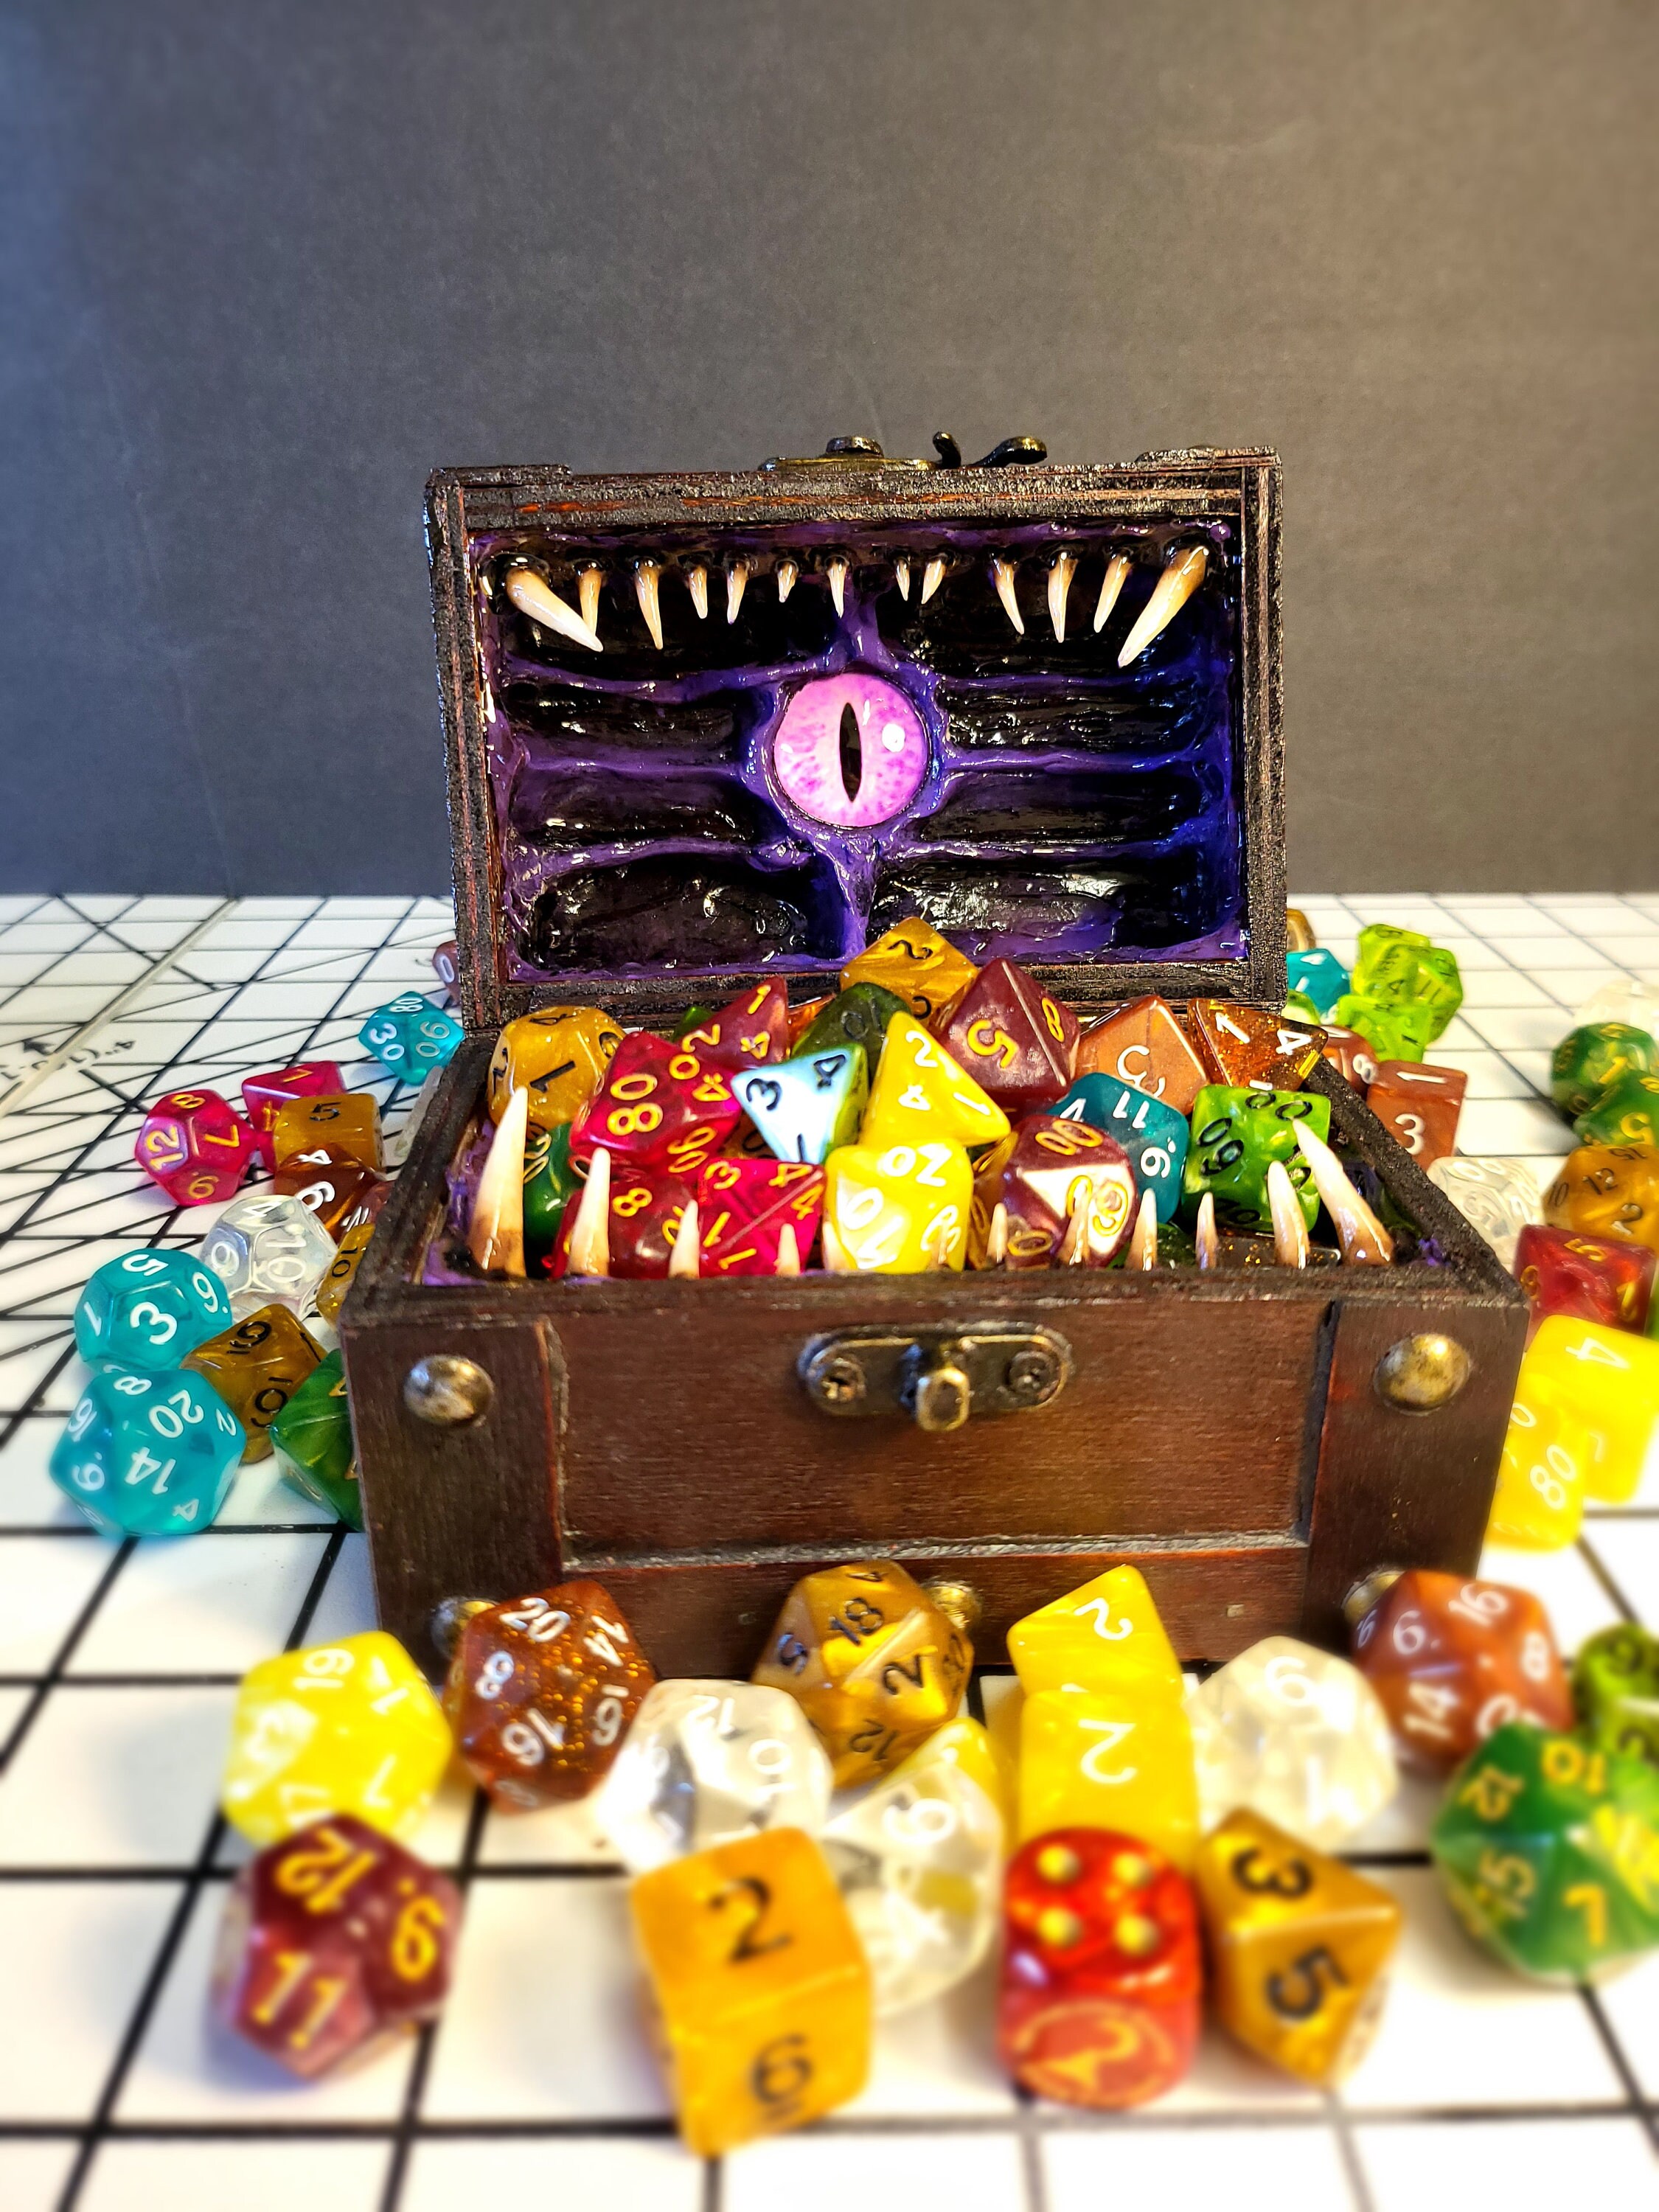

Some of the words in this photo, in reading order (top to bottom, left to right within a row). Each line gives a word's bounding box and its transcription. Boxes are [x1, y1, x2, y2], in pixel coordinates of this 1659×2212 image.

[887, 939, 933, 960] 2
[389, 998, 424, 1013] 80
[748, 984, 771, 1015] 1
[682, 1023, 721, 1053] 2
[1040, 997, 1065, 1043] 8
[1216, 1012, 1251, 1045] 1
[370, 1023, 405, 1061] 30
[740, 1032, 771, 1060] 4
[905, 1031, 939, 1068] 2
[967, 1020, 1016, 1069] 5
[1276, 1029, 1312, 1055] 4
[529, 1060, 577, 1093] 1
[813, 1054, 846, 1091] 4
[1352, 1054, 1378, 1085] 8
[1396, 1071, 1447, 1085] 1
[1598, 1056, 1629, 1085] 1
[171, 1093, 206, 1109] 8
[309, 1102, 342, 1121] 5
[607, 1074, 664, 1135] 80
[746, 1077, 782, 1111] 3
[898, 1085, 932, 1111] 4
[952, 1091, 991, 1117] 1
[1113, 1091, 1150, 1129] 11
[1245, 1092, 1313, 1121] 00
[262, 1101, 281, 1132] 4
[1395, 1113, 1425, 1155] 3
[145, 1125, 184, 1171] 12
[204, 1124, 240, 1148] 7
[1035, 1119, 1104, 1156] 00
[704, 1161, 742, 1190] 3
[768, 1163, 813, 1188] 4
[1581, 1167, 1618, 1196] 12
[243, 1200, 283, 1218] 4
[613, 1187, 653, 1217] 8
[790, 1183, 826, 1220] 4
[1610, 1203, 1644, 1237] 2
[702, 1211, 732, 1248] 1
[122, 1253, 170, 1276] 5
[265, 1234, 307, 1284] 10
[717, 1247, 757, 1270] 1
[1563, 1239, 1609, 1262] 5
[83, 1302, 102, 1337] 1
[130, 1301, 178, 1346] 3
[1565, 1337, 1632, 1370] 4
[113, 1375, 153, 1396] 8
[148, 1389, 205, 1439] 20
[215, 1408, 237, 1436] 2
[124, 1446, 177, 1495] 14
[1529, 1444, 1578, 1510] 80
[172, 1498, 200, 1523] 4
[499, 1597, 571, 1643] 20
[830, 1597, 883, 1646] 18
[1074, 1598, 1133, 1641] 2
[1447, 1582, 1508, 1627] 16
[583, 1615, 630, 1667] 14
[1520, 1631, 1550, 1683] 8
[292, 1647, 355, 1691] 19
[476, 1650, 515, 1700] 8
[882, 1653, 923, 1696] 2
[501, 1707, 566, 1767] 16
[1079, 1719, 1139, 1787] 2
[274, 1827, 378, 1913] 12
[1230, 1846, 1314, 1902] 3
[706, 1875, 794, 1966] 2
[247, 1950, 347, 2051] 11
[1261, 1944, 1349, 2022] 5
[747, 2031, 815, 2119] 6
